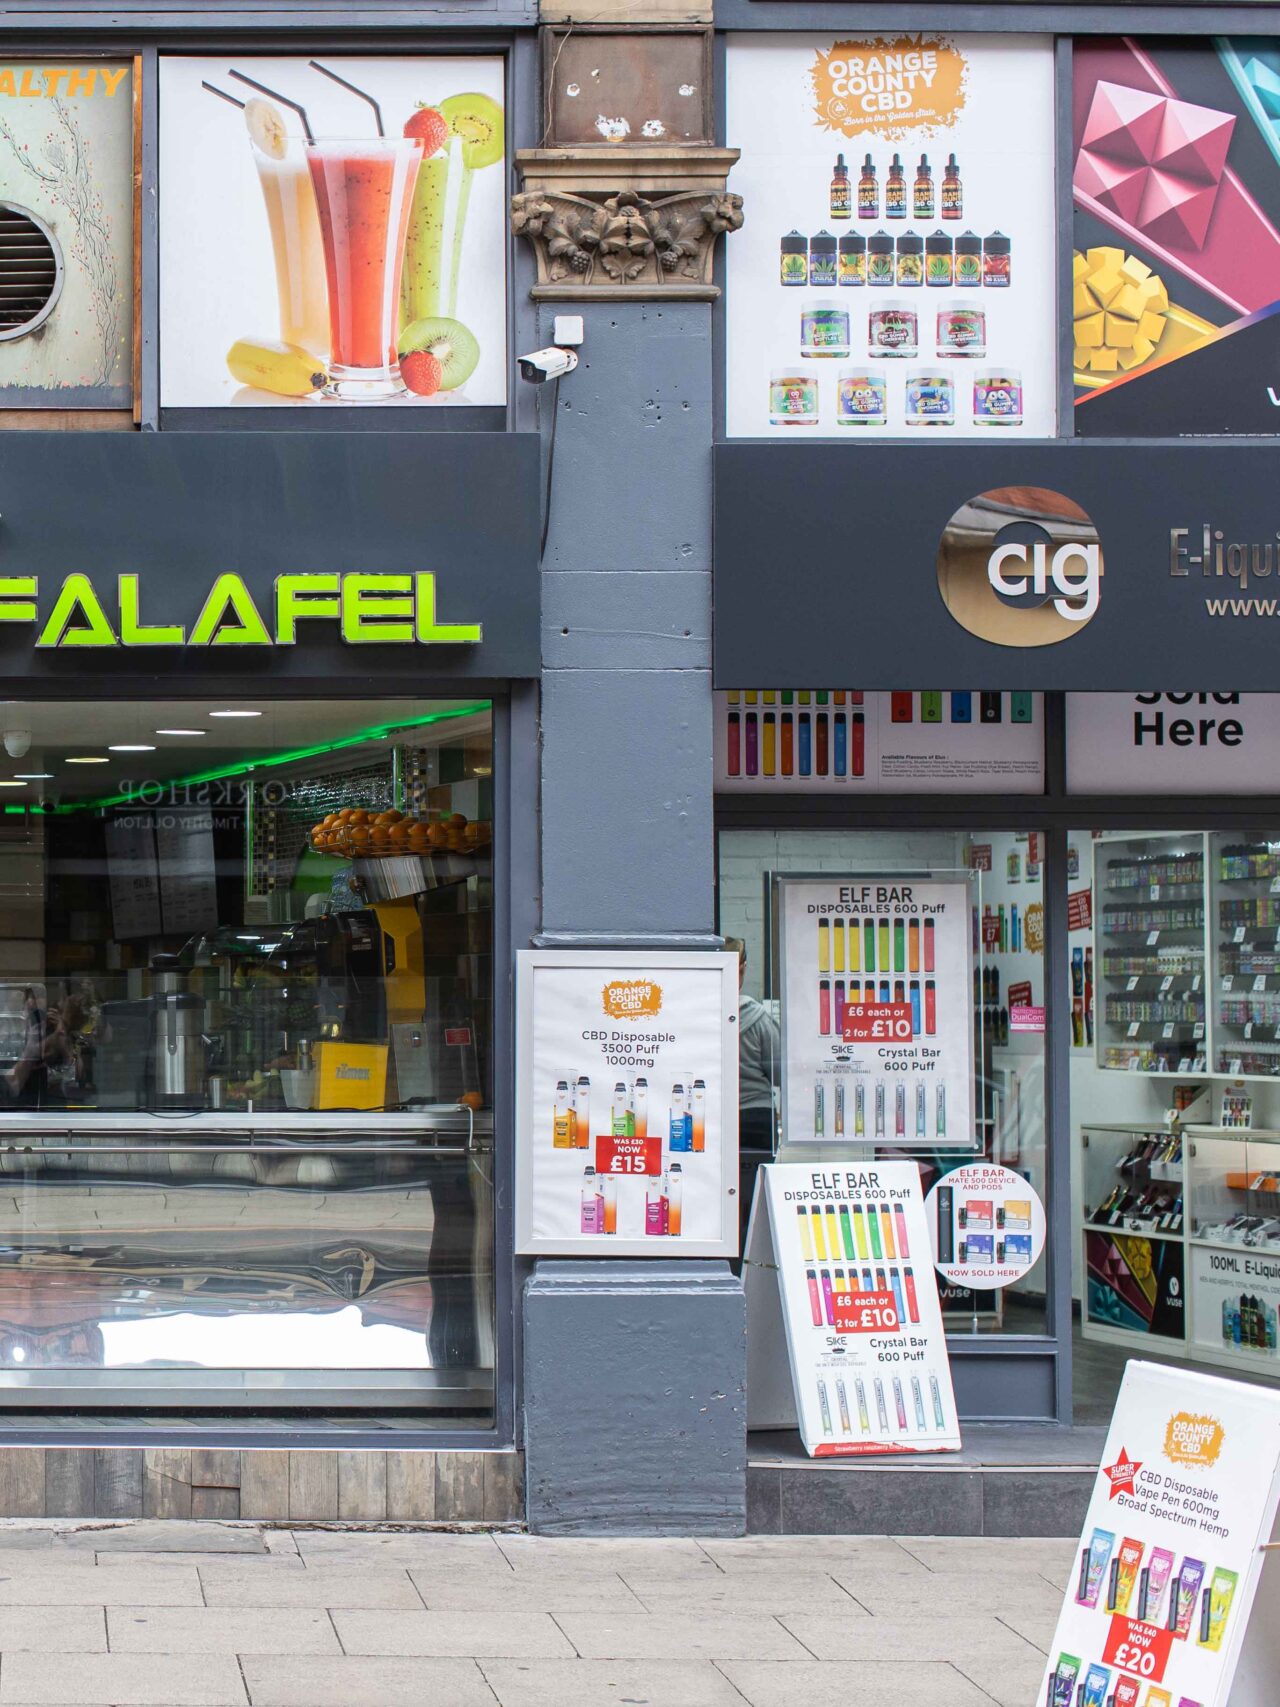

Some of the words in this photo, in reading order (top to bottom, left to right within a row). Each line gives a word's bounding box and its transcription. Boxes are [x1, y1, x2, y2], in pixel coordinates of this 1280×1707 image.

[828, 50, 937, 79] ORANGE
[832, 69, 937, 97] COUNTY
[860, 90, 912, 112] CBD
[1134, 712, 1244, 746] Here
[840, 887, 871, 903] ELF
[876, 887, 913, 903] BAR
[808, 904, 891, 914] DISPOSABLES
[894, 904, 918, 913] 600
[922, 904, 945, 913] Puff
[609, 986, 652, 996] ORANGE
[610, 993, 651, 1003] COUNTY
[621, 1002, 642, 1010] CBD
[848, 1007, 864, 1017] £6
[868, 1008, 891, 1017] each
[1011, 1013, 1045, 1021] DualCom
[845, 1029, 852, 1037] 2
[853, 1029, 868, 1037] for
[872, 1020, 911, 1038] £10
[582, 1031, 608, 1041] CBD
[612, 1032, 676, 1043] Disposable
[601, 1044, 632, 1053] 3500
[636, 1044, 660, 1054] Puff
[878, 1048, 918, 1059] Crystal
[922, 1048, 941, 1057] Bar
[606, 1056, 655, 1068] 1000mg
[884, 1062, 908, 1071] 600
[912, 1062, 936, 1071] Puff
[618, 1146, 641, 1154] NOW
[611, 1156, 646, 1172] £15
[960, 1169, 980, 1178] ELF
[982, 1169, 1005, 1178] BAR
[811, 1173, 841, 1190] ELF
[846, 1173, 881, 1189] BAR
[785, 1190, 862, 1201] DISPOSABLES
[865, 1190, 887, 1199] 600
[890, 1189, 911, 1199] Puff
[1210, 1256, 1240, 1273] 100ML
[940, 1289, 971, 1298] vuse
[837, 1296, 852, 1307] £6
[855, 1297, 876, 1306] each
[879, 1297, 889, 1305] or
[1166, 1298, 1183, 1308] vuse
[837, 1320, 844, 1328] 2
[845, 1318, 858, 1328] for
[860, 1308, 897, 1327] £10
[870, 1338, 907, 1349] Crystal
[910, 1338, 928, 1347] Bar
[878, 1352, 900, 1362] 600
[903, 1351, 925, 1361] Puff
[1173, 1421, 1215, 1435] ORANGE
[1173, 1432, 1213, 1445] COUNTY
[1181, 1442, 1201, 1453] CBD
[1111, 1464, 1135, 1474] SUPER
[1140, 1471, 1162, 1485] CBD
[1164, 1478, 1219, 1503] Disposable
[1135, 1484, 1159, 1501] Vape
[1162, 1492, 1180, 1507] Pen
[1182, 1498, 1220, 1521] 600mg
[1117, 1495, 1148, 1512] Broad
[1149, 1504, 1197, 1528] Spectrum
[1199, 1519, 1229, 1539] Hemp
[1127, 1621, 1143, 1633] WAS
[1144, 1626, 1157, 1638] £40
[1128, 1633, 1152, 1648] NOW
[1114, 1644, 1156, 1676] £20
